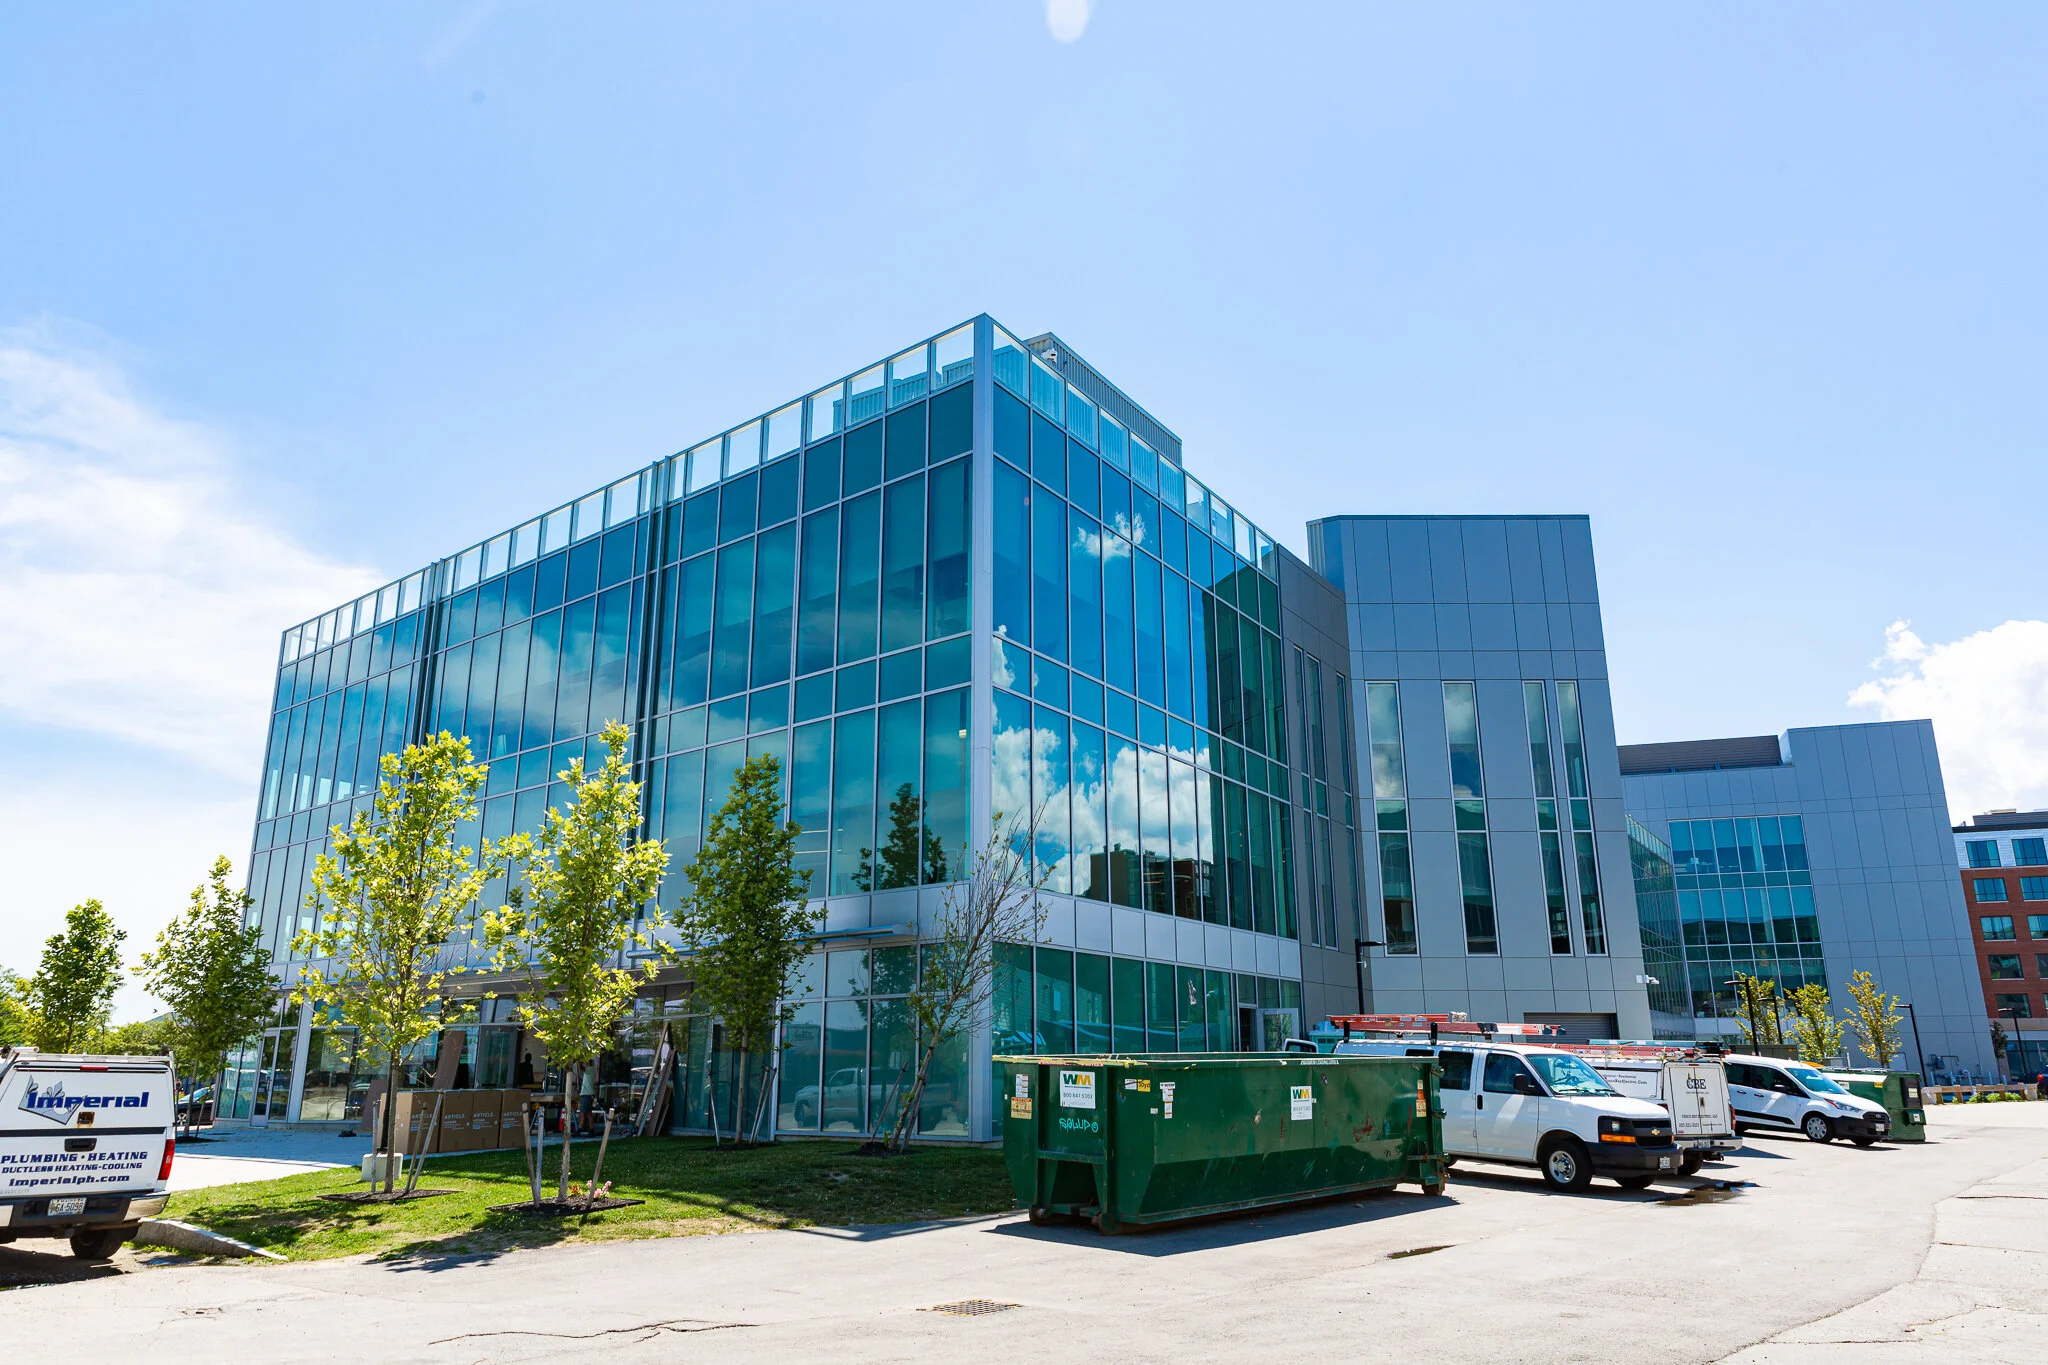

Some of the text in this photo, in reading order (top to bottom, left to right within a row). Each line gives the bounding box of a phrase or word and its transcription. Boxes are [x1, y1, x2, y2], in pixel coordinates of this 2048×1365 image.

[1063, 1073, 1092, 1086] WM
[1686, 1078, 1707, 1090] CBE
[1292, 1088, 1310, 1099] WM
[27, 1092, 149, 1108] Imperial
[0, 1151, 148, 1164] PLUMBING HEATING
[1, 1162, 143, 1173] DUCTLESS HEATING-COOLING
